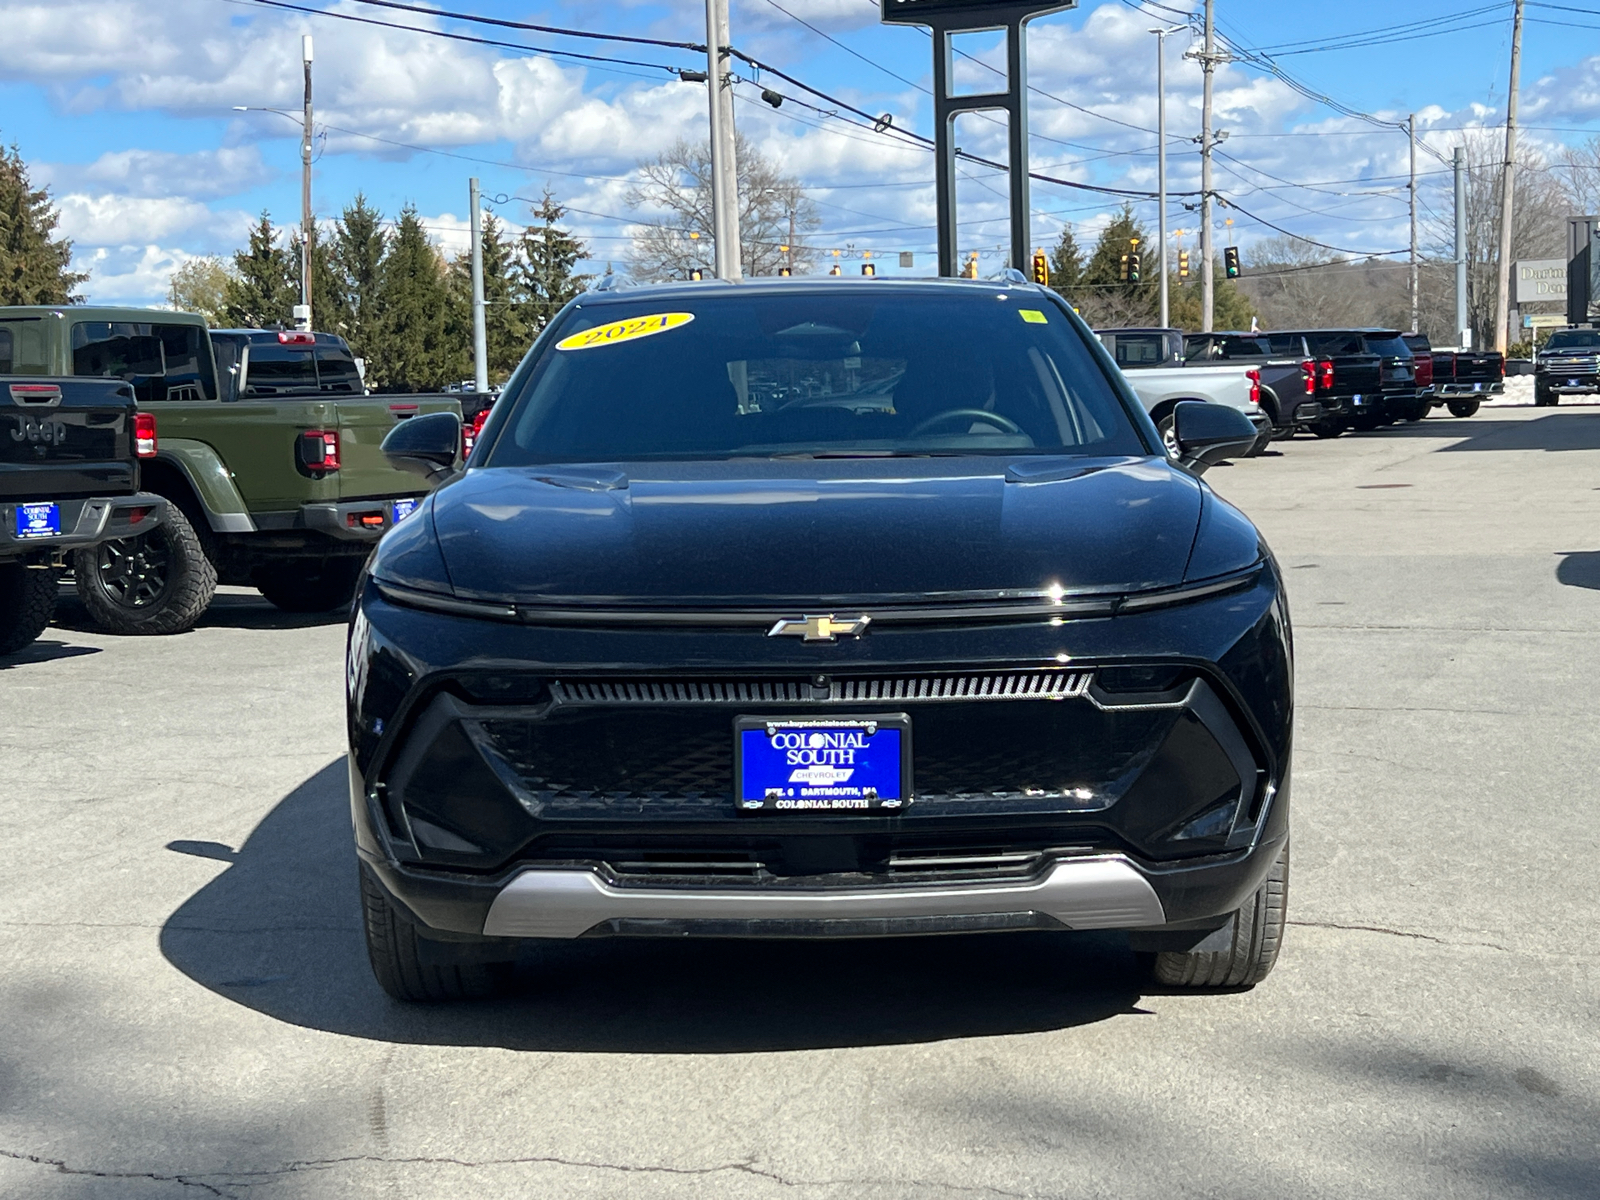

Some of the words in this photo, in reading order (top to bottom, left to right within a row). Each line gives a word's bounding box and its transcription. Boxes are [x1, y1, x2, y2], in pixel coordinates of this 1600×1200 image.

[584, 316, 667, 345] 2024
[10, 415, 67, 446] Jeep
[771, 732, 870, 750] COLONIAL
[786, 749, 854, 765] SOUTH
[796, 771, 846, 779] CHEVROLET
[800, 787, 861, 797] DARTMOUTH,
[775, 799, 831, 809] COLONIAL
[831, 799, 869, 809] SOUTH
